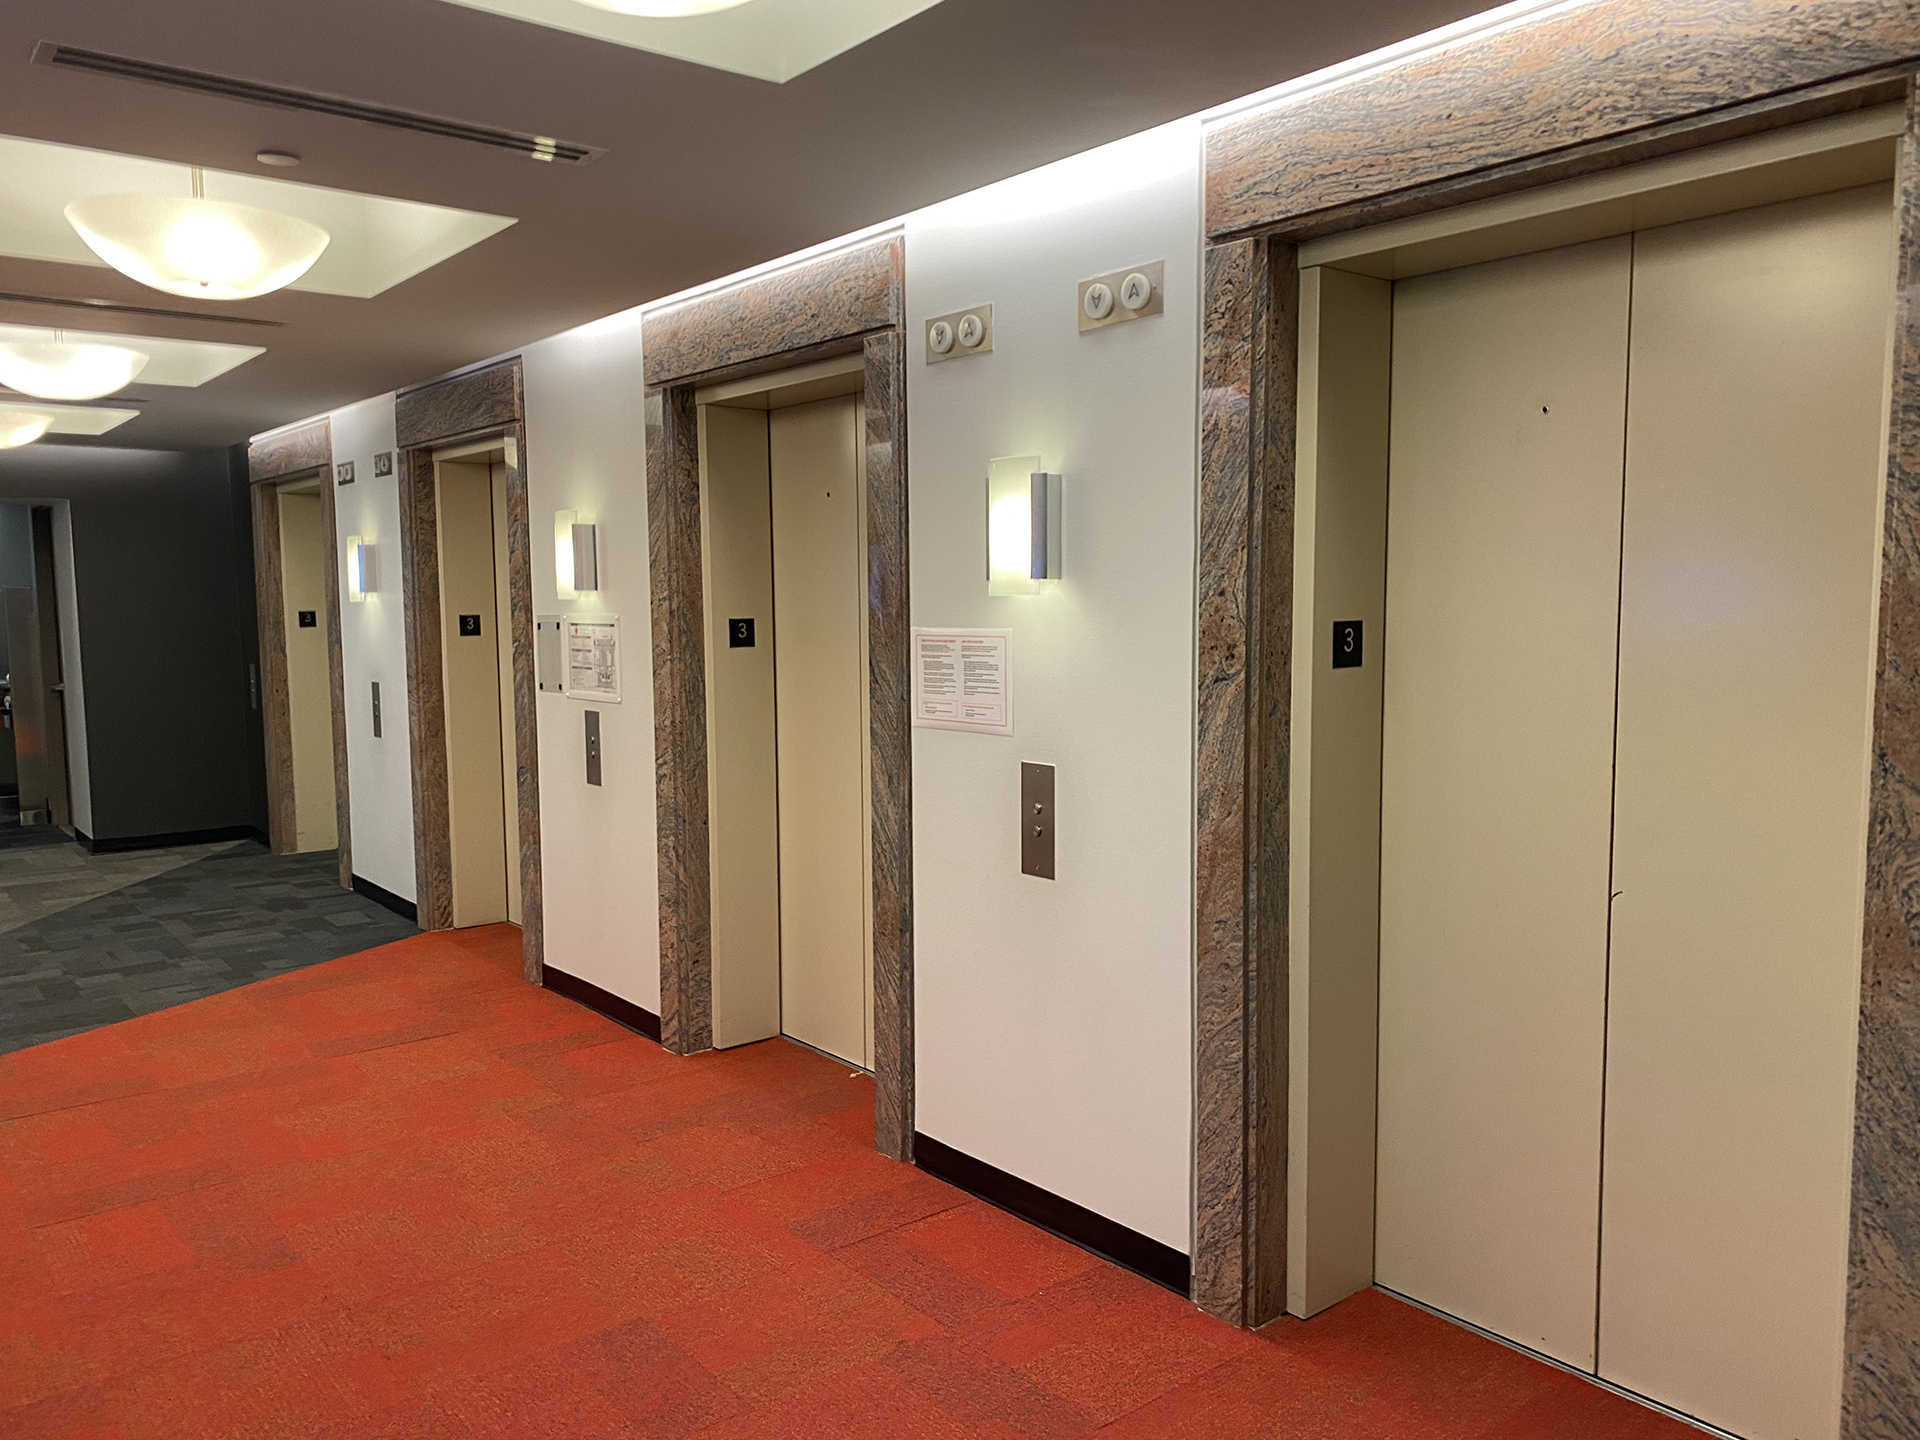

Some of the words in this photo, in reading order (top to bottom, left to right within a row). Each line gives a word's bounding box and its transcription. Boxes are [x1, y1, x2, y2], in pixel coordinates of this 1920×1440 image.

[466, 617, 474, 630] 3
[738, 622, 747, 638] 3
[1343, 627, 1354, 653] 3
